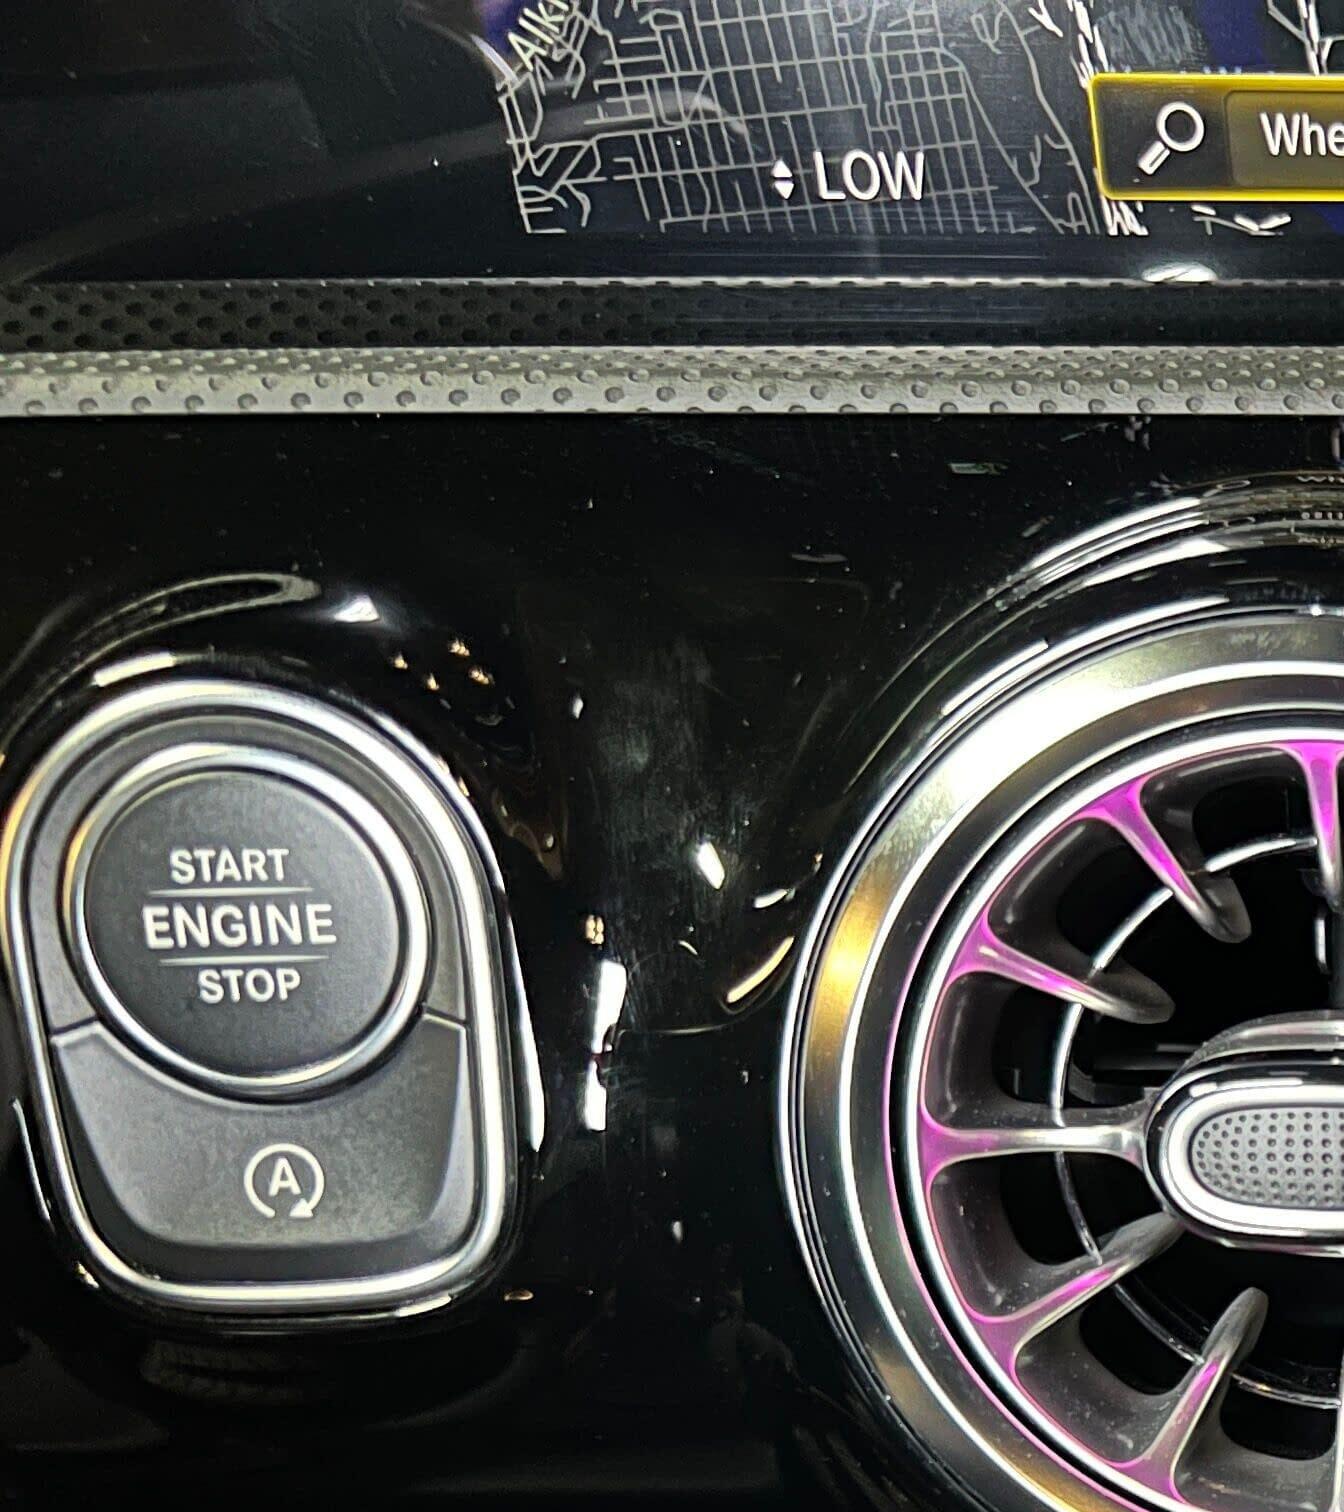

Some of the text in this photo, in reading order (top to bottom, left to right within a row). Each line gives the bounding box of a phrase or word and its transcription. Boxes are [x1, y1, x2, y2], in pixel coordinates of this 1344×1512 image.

[813, 149, 925, 201] LOW
[169, 848, 289, 884] START
[142, 903, 337, 950] ENGINE
[198, 967, 300, 1004] STOP
[267, 1157, 300, 1197] A
